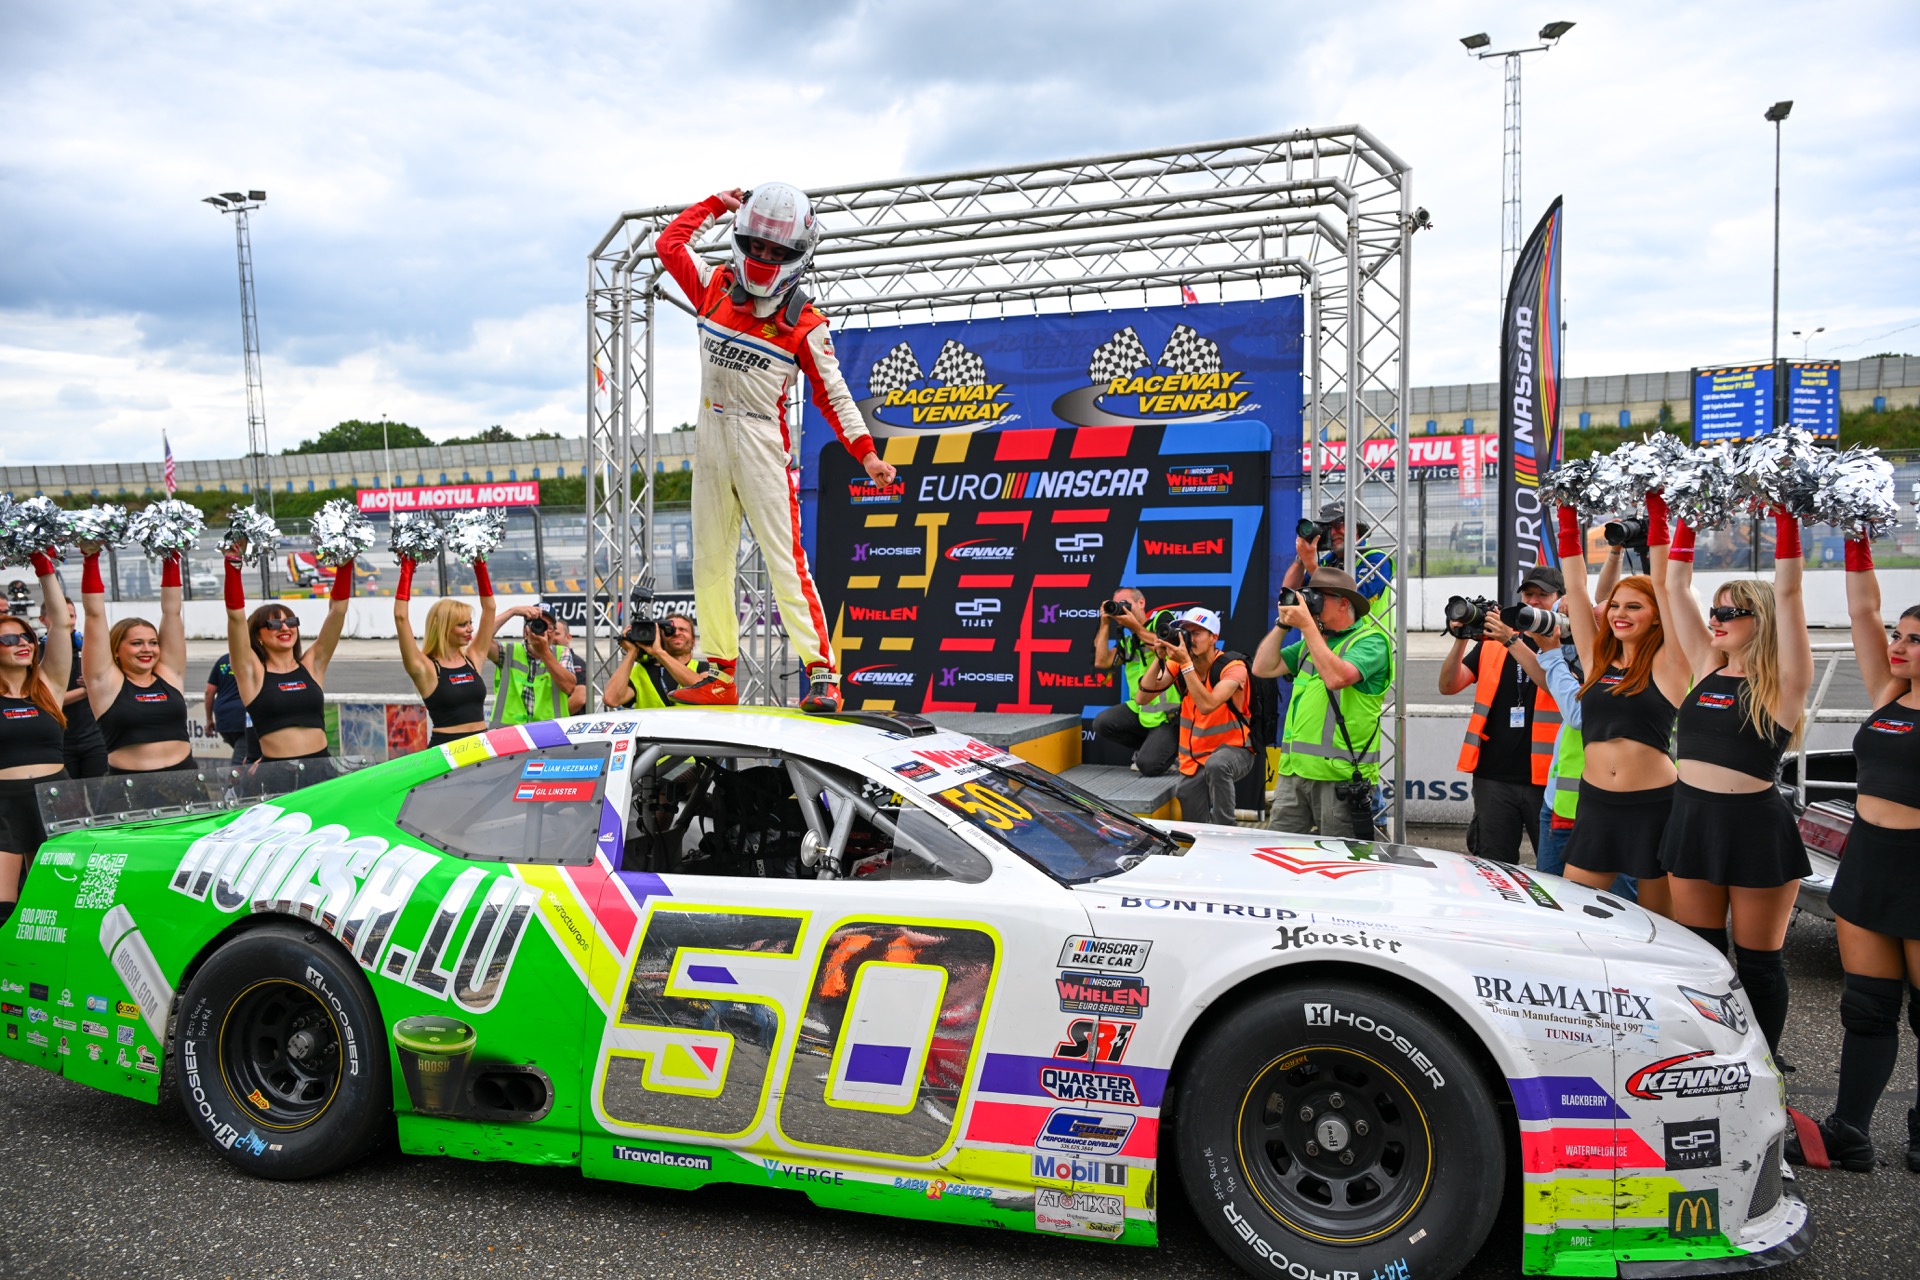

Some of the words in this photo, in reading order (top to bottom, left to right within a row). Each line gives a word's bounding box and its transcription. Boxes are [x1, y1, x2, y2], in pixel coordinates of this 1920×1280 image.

[704, 337, 771, 371] HEZEBERG
[709, 354, 750, 373] SYSTEMS
[1106, 371, 1242, 395] RACEWAY
[1513, 306, 1533, 444] NASCAR
[884, 383, 1004, 406] RACEWAY
[1137, 391, 1249, 413] VENRAY
[912, 401, 1010, 422] VENRAY
[918, 472, 1004, 501] EURO
[1036, 468, 1149, 499] NASCAR
[1166, 471, 1233, 486] WHELEN
[361, 491, 416, 509] MOTUL
[418, 489, 475, 506] MOTUL
[477, 486, 536, 504] MOTUL
[848, 482, 906, 497] WHELEN
[869, 547, 921, 556] HOOSIER
[949, 546, 1015, 558] KENNOL
[1143, 538, 1224, 555] WHELEN
[1062, 554, 1096, 563] TIJEY
[849, 606, 918, 621] WHELEN
[961, 619, 994, 627] TIJEY
[1059, 609, 1101, 618] HOOSI
[852, 672, 915, 683] KENNOL
[958, 672, 1014, 682] HOOSIER
[1699, 694, 1735, 706] WHELEN
[1871, 720, 1915, 732] WHELEN
[561, 764, 599, 772] HEZEMANS
[536, 788, 547, 796] GIL
[548, 787, 577, 796] LINSTER
[940, 782, 1032, 830] 50
[40, 852, 52, 865] GET
[52, 852, 75, 866] YOURS
[20, 908, 34, 923] 600
[34, 909, 58, 925] PUFFS
[168, 804, 543, 1014] HOOSH.LU
[1120, 896, 1297, 920] BONTRUP
[546, 890, 590, 952] abstractwraps
[16, 924, 34, 940] ZERO
[34, 925, 68, 943] NICOTINE
[1272, 926, 1403, 954] Hoosier
[1089, 940, 1138, 956] NASCAR
[1072, 954, 1104, 966] RACE
[1108, 956, 1133, 967] CAR
[117, 948, 159, 1019] HOOSH.COM
[1092, 977, 1122, 988] NASCAR
[1057, 980, 1149, 1007] WHELEN
[1472, 975, 1655, 1021] BRAMATEX
[1078, 1002, 1098, 1011] EURO
[1098, 1003, 1126, 1014] SERIES
[320, 982, 359, 1076] HOOSIER
[1491, 1005, 1519, 1019] Denim
[1520, 1012, 1594, 1029] Manufacturing
[1595, 1018, 1620, 1031] Since
[1622, 1022, 1644, 1035] 1997
[597, 900, 1004, 1163] 50
[1544, 1028, 1594, 1044] TUNISIA
[1334, 1009, 1446, 1090] HOOSIER
[417, 1058, 451, 1073] HOOSH
[184, 1040, 223, 1132] HOOSIER
[1042, 1069, 1131, 1091] QUARTER
[1637, 1065, 1750, 1091] KENNOL
[1738, 1082, 1749, 1090] OIL
[1058, 1084, 1136, 1104] MASTER
[1561, 1094, 1608, 1107] BLACKBERRY
[1042, 1136, 1087, 1146] PERFORMANCE
[1087, 1140, 1119, 1149] DRIVELINE
[1565, 1145, 1615, 1157] WATERMELON
[1616, 1146, 1628, 1157] ICE
[616, 1145, 709, 1170] Travala.com
[1679, 1151, 1710, 1161] TIJEY
[783, 1165, 844, 1187] VERGE
[1034, 1154, 1099, 1183] Mobil
[893, 1177, 928, 1194] BABY
[945, 1183, 993, 1200] CENTER
[1213, 1180, 1226, 1200] #50
[1046, 1217, 1072, 1225] brembo
[1223, 1201, 1330, 1280] HOOSIER
[1570, 1236, 1593, 1247] APPLE
